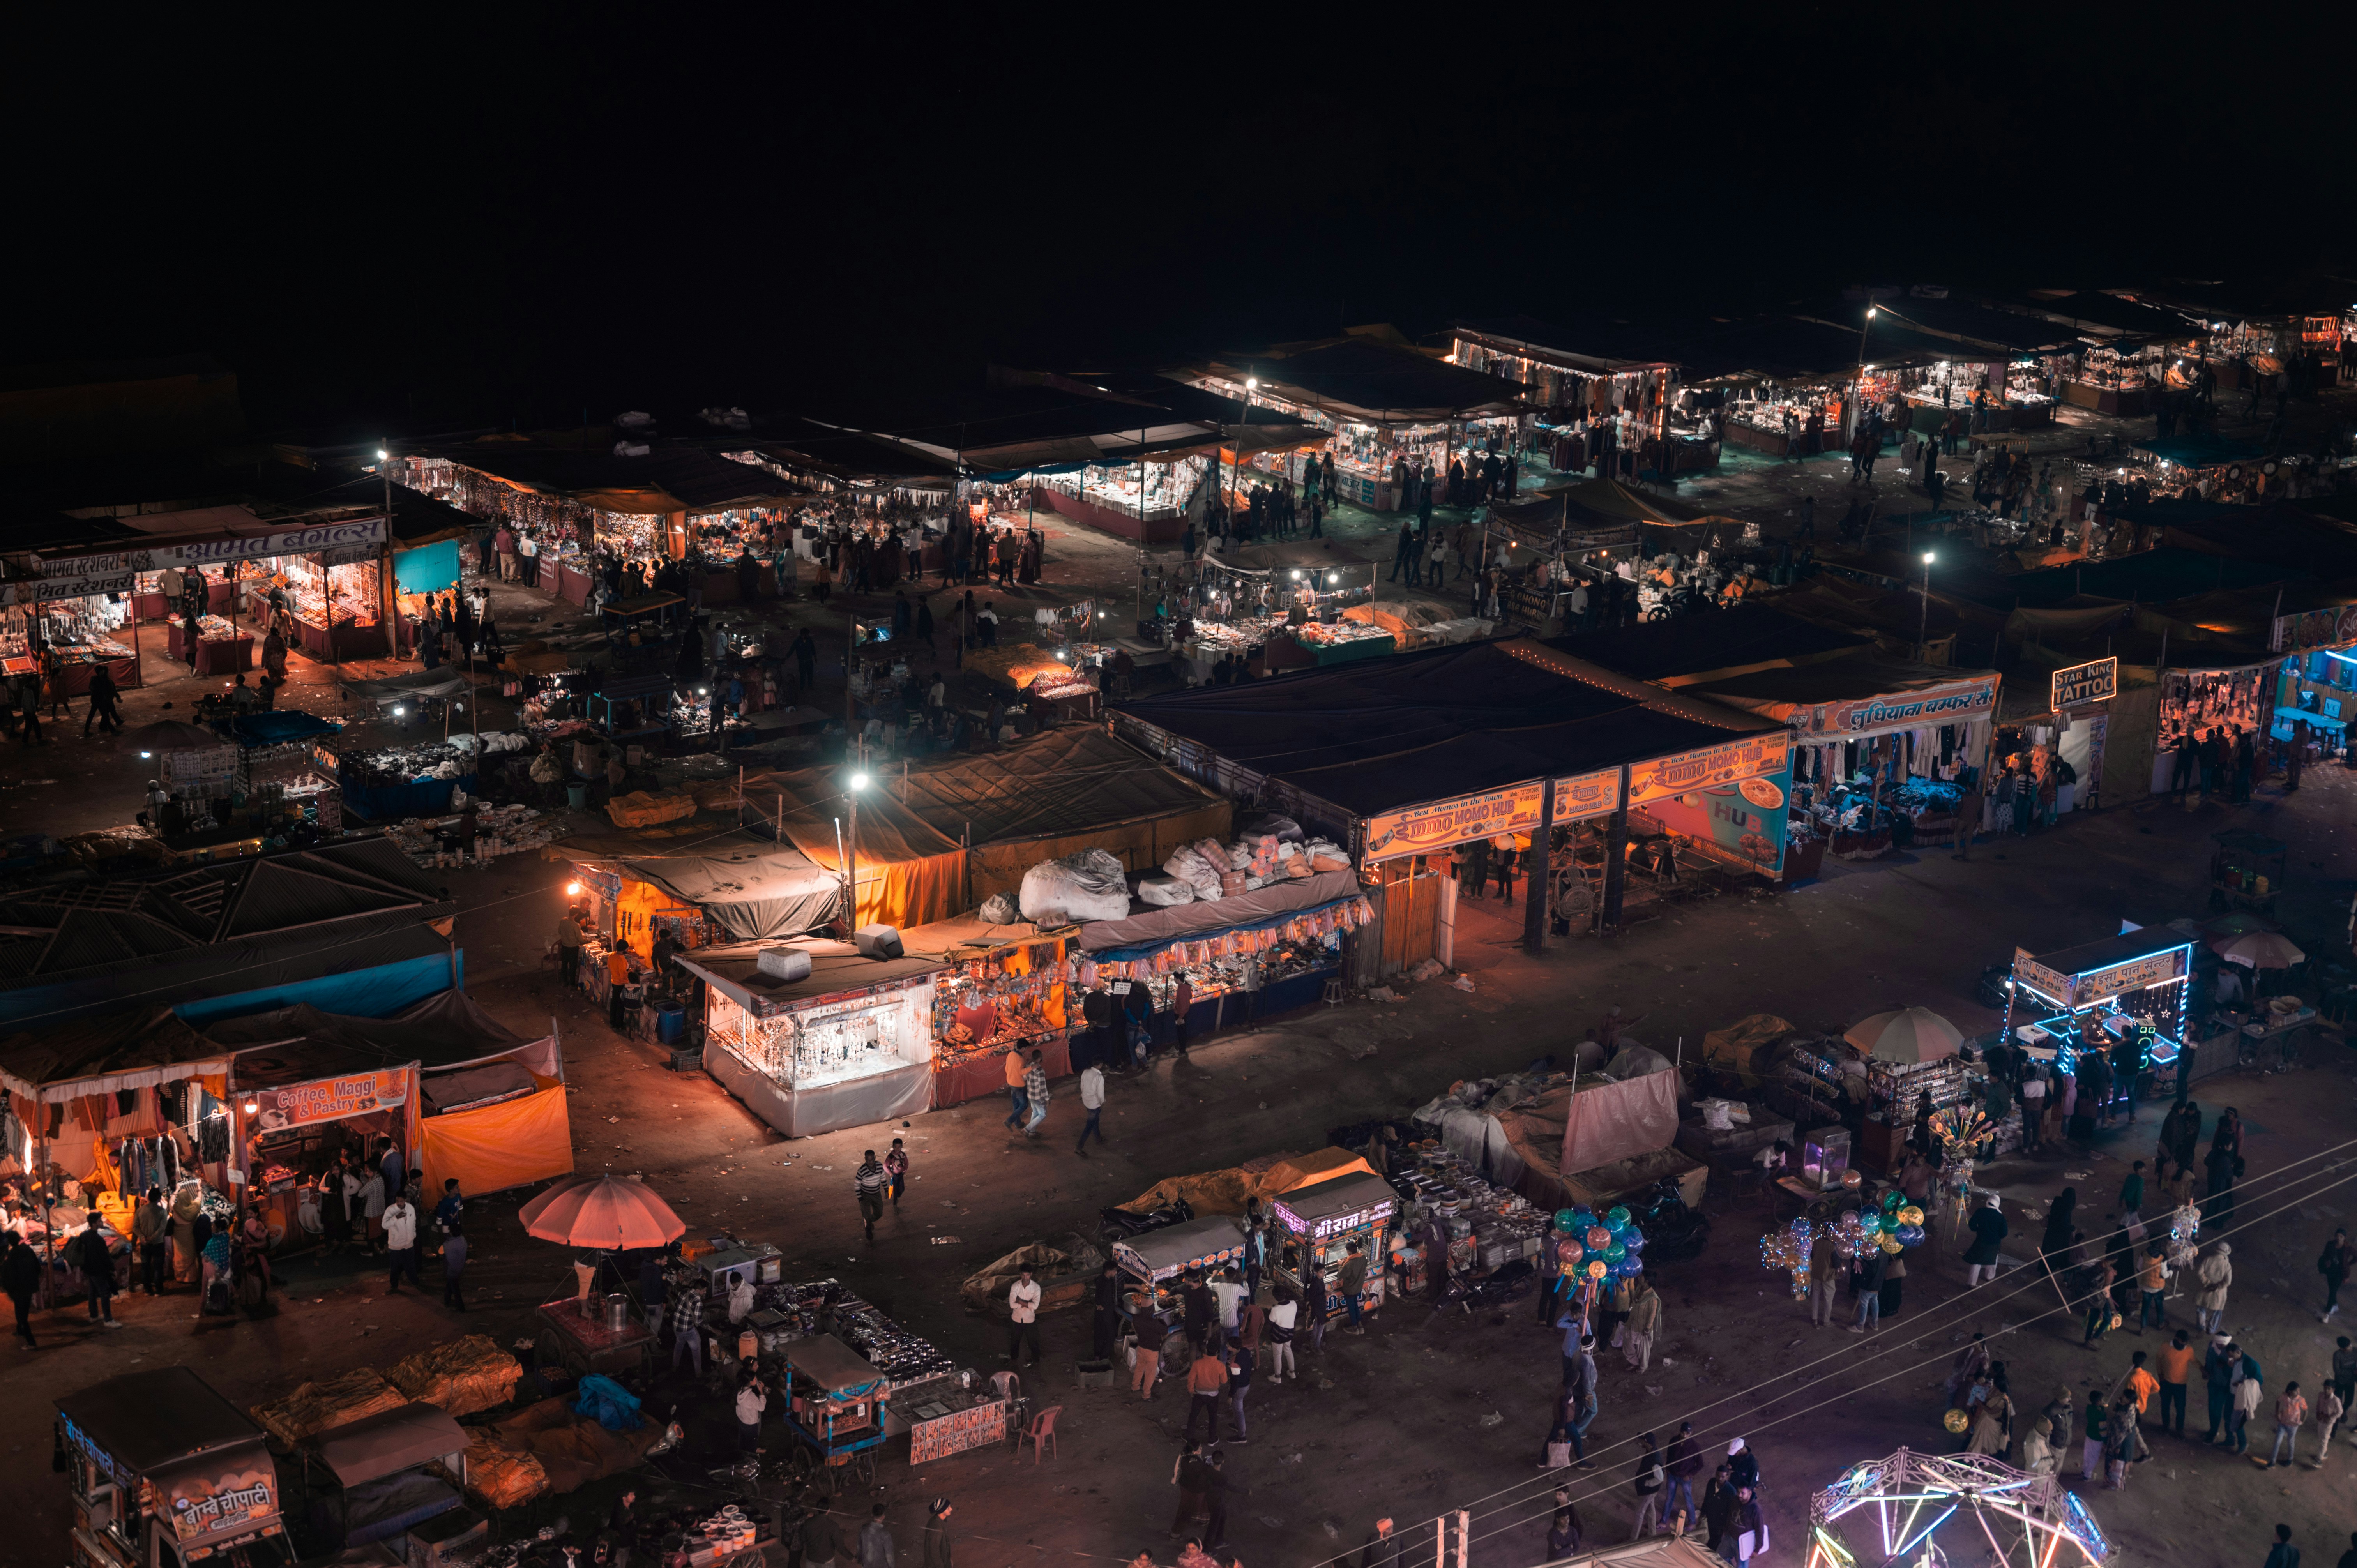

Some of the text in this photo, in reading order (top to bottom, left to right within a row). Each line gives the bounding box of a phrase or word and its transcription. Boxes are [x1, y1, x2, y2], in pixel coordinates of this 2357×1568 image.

[37, 583, 69, 599] मित
[2054, 675, 2114, 704] TATTOO
[1850, 701, 1925, 731] लुधियाना
[1687, 750, 1712, 760] Momos
[1735, 741, 1752, 749] Town
[1707, 751, 1740, 772] MOMO
[1741, 746, 1763, 764] HUB
[1414, 809, 1429, 818] Best
[1431, 803, 1459, 814] Momos
[1470, 795, 1482, 805] the
[1483, 794, 1503, 803] Town
[1454, 804, 1490, 825] MOMO
[1492, 799, 1515, 817] HUB
[1569, 801, 1602, 814] MOMO HUB
[1714, 801, 1762, 833] HUB
[2035, 963, 2050, 978] पान
[2121, 964, 2141, 978] पान
[278, 1076, 376, 1108] Coffee, Maggi
[299, 1098, 355, 1117] & Pastry
[1333, 1212, 1360, 1231] राम
[184, 1483, 270, 1525] बोम्बे चौपाटी
